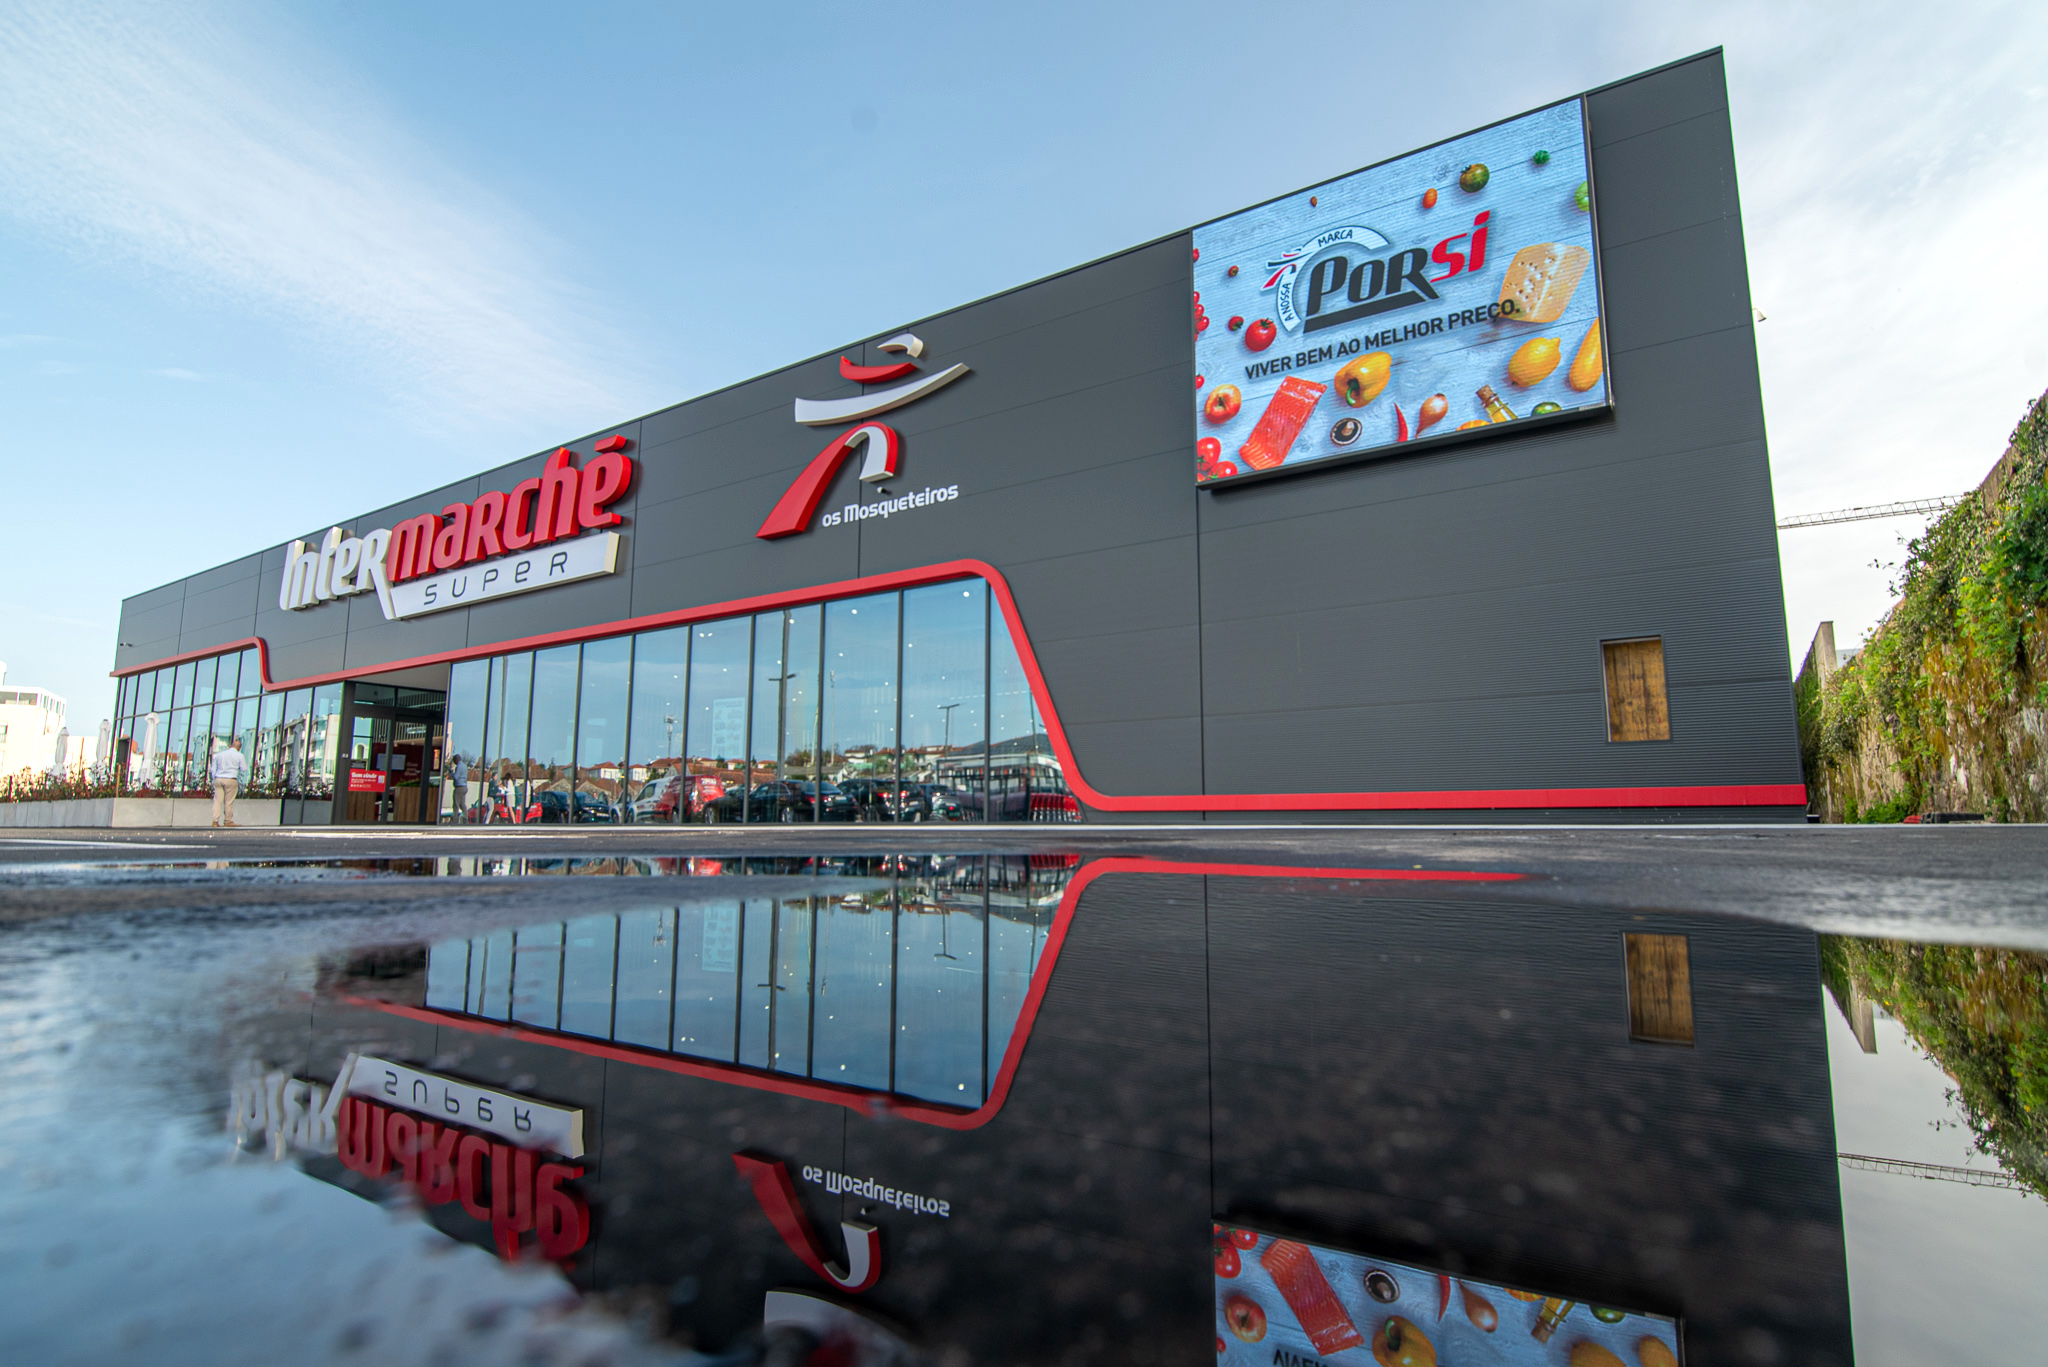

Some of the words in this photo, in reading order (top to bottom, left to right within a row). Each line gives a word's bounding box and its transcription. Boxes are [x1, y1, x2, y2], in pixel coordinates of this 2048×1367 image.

[1318, 229, 1353, 247] MARCA
[1280, 282, 1292, 315] NOSSA
[1284, 314, 1294, 322] A
[1245, 356, 1292, 380] VIVER
[1296, 344, 1333, 368] BEM
[1337, 338, 1361, 358] AO
[1365, 317, 1444, 350] MELHOR
[1448, 298, 1521, 330] PREÇO.
[822, 512, 842, 527] os
[844, 485, 959, 519] Mosqueteiros
[423, 551, 568, 606] SUPER
